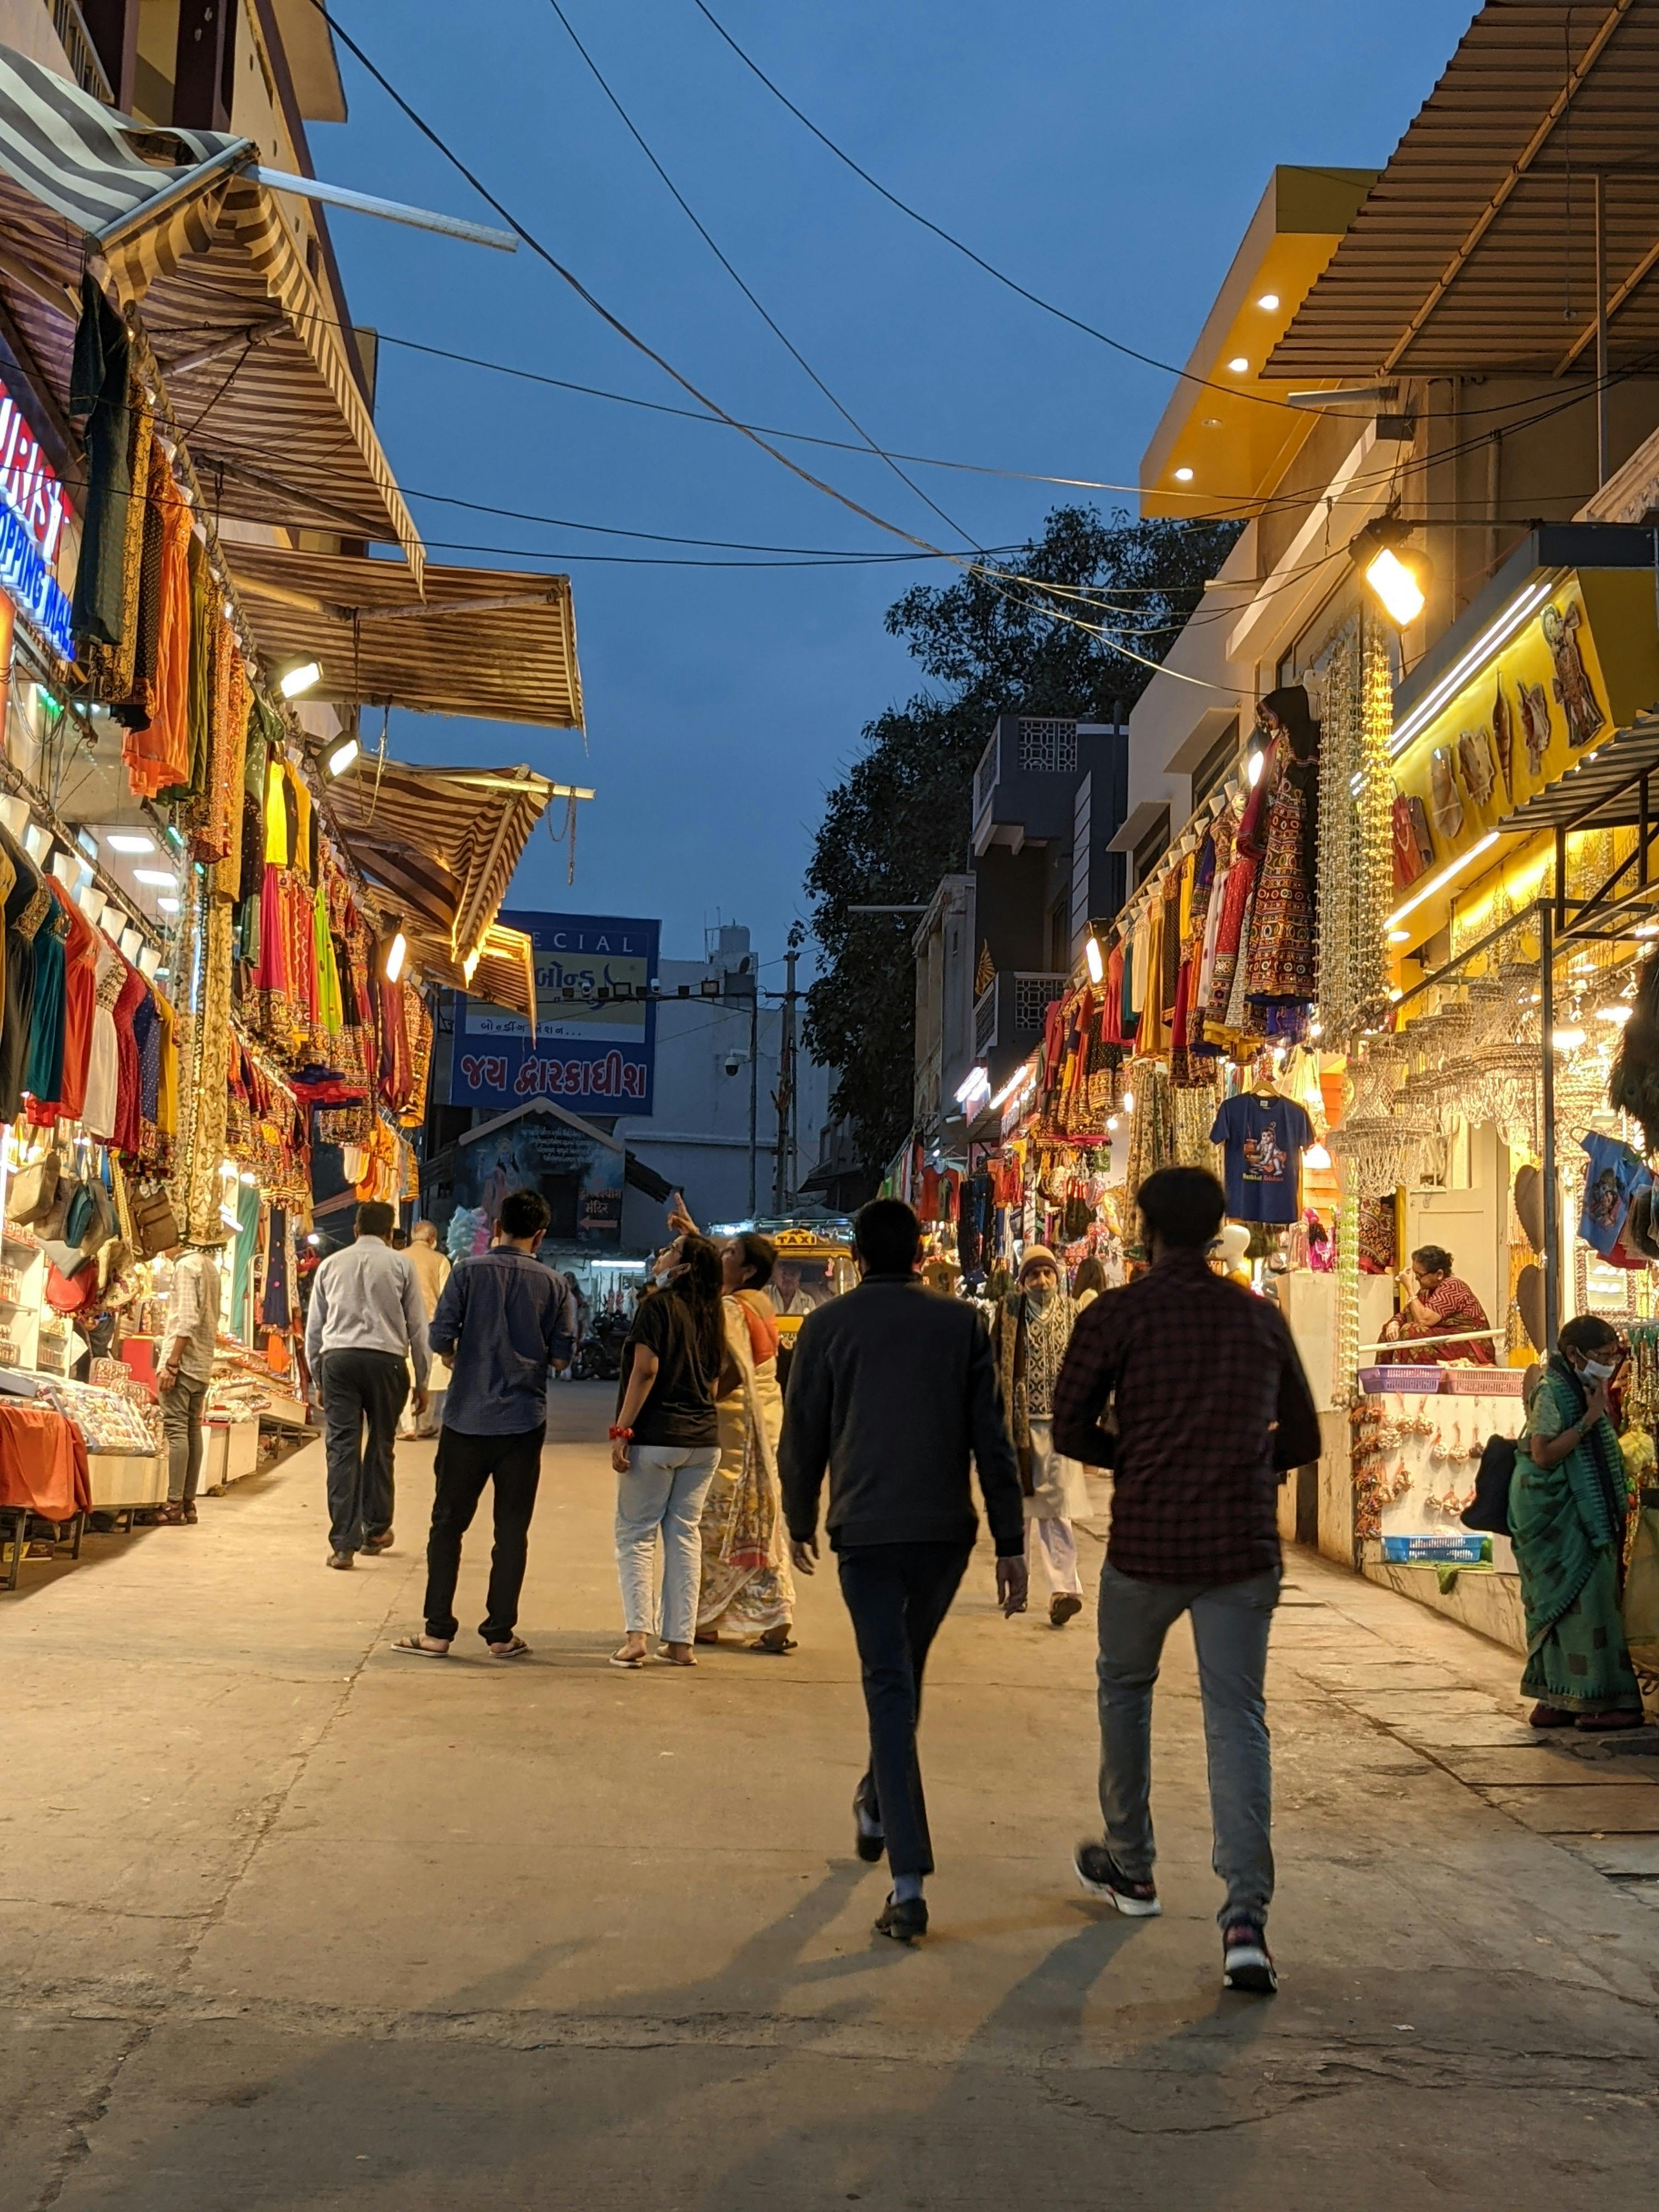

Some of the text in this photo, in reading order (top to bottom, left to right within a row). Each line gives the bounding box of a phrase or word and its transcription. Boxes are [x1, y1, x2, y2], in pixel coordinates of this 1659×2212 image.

[461, 1049, 646, 1098] જય દ્વારકાધીશ
[777, 1236, 815, 1244] TAXI
